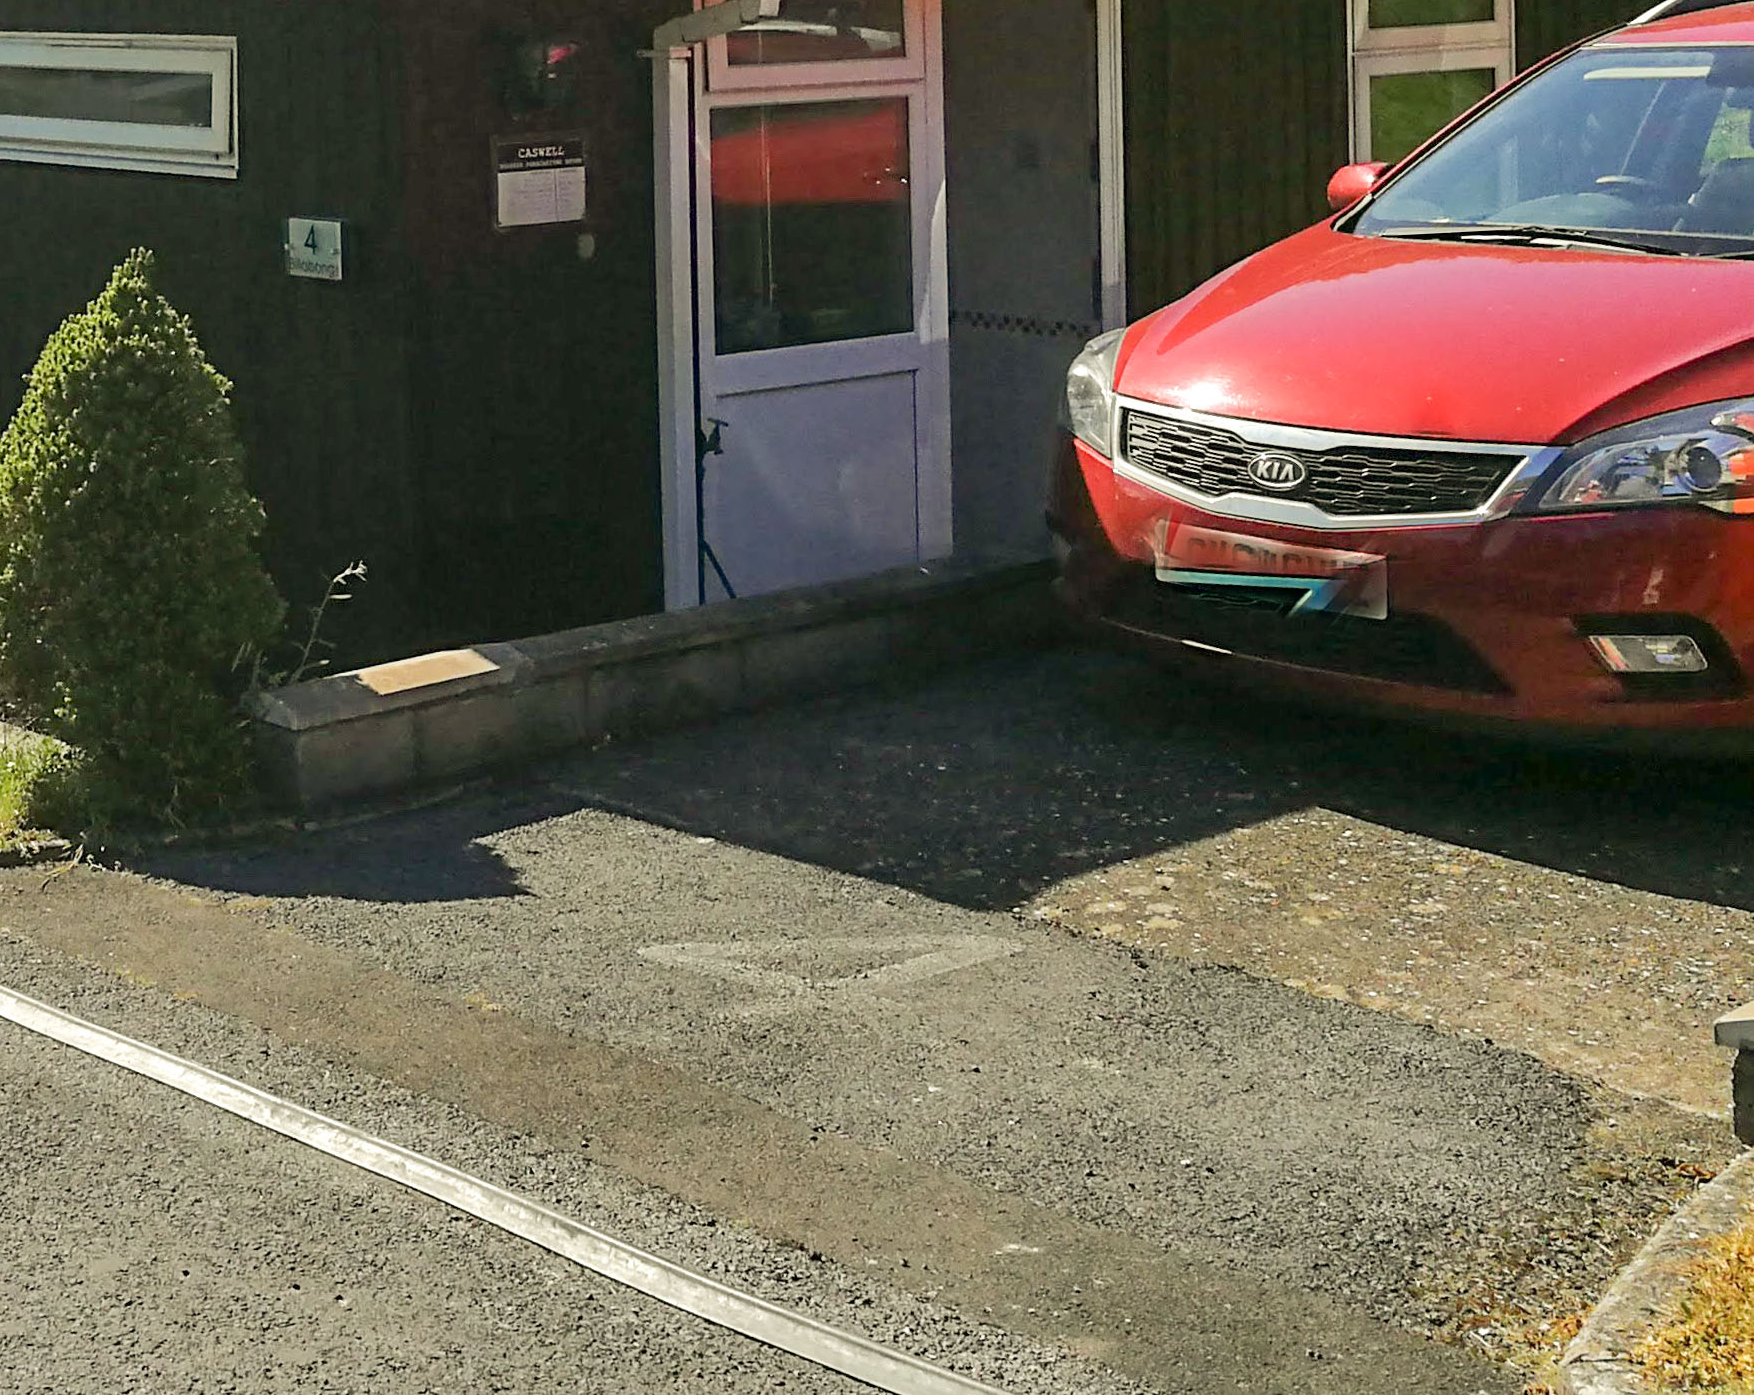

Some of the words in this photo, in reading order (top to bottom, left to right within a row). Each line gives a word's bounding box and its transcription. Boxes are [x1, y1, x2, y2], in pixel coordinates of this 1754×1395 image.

[518, 146, 565, 158] CASWELL
[304, 225, 317, 255] 4
[1256, 460, 1295, 481] KIA
